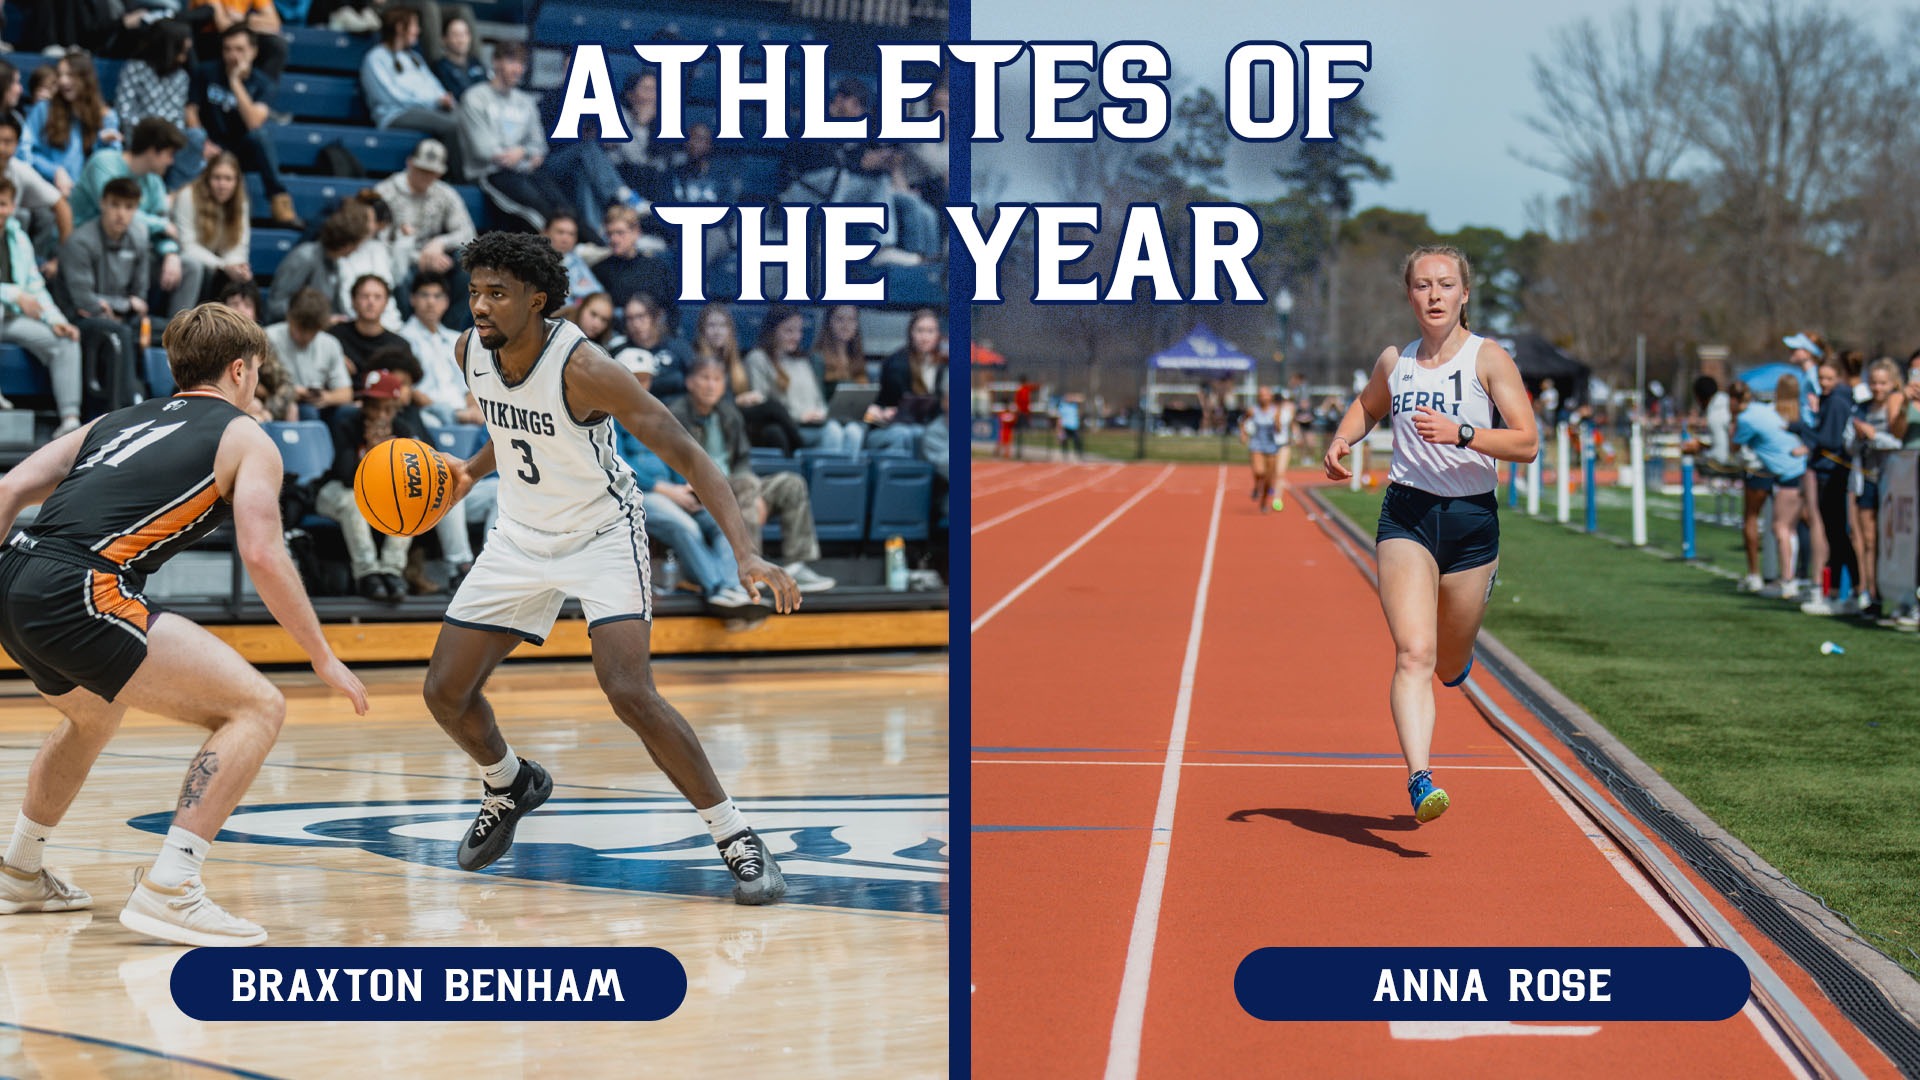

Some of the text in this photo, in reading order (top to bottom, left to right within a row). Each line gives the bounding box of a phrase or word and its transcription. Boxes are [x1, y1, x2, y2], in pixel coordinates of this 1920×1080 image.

[1448, 369, 1463, 401] 1
[478, 396, 556, 437] VIKINGS
[75, 418, 188, 468] 11
[510, 438, 541, 485] 3
[403, 452, 423, 499] NCAA
